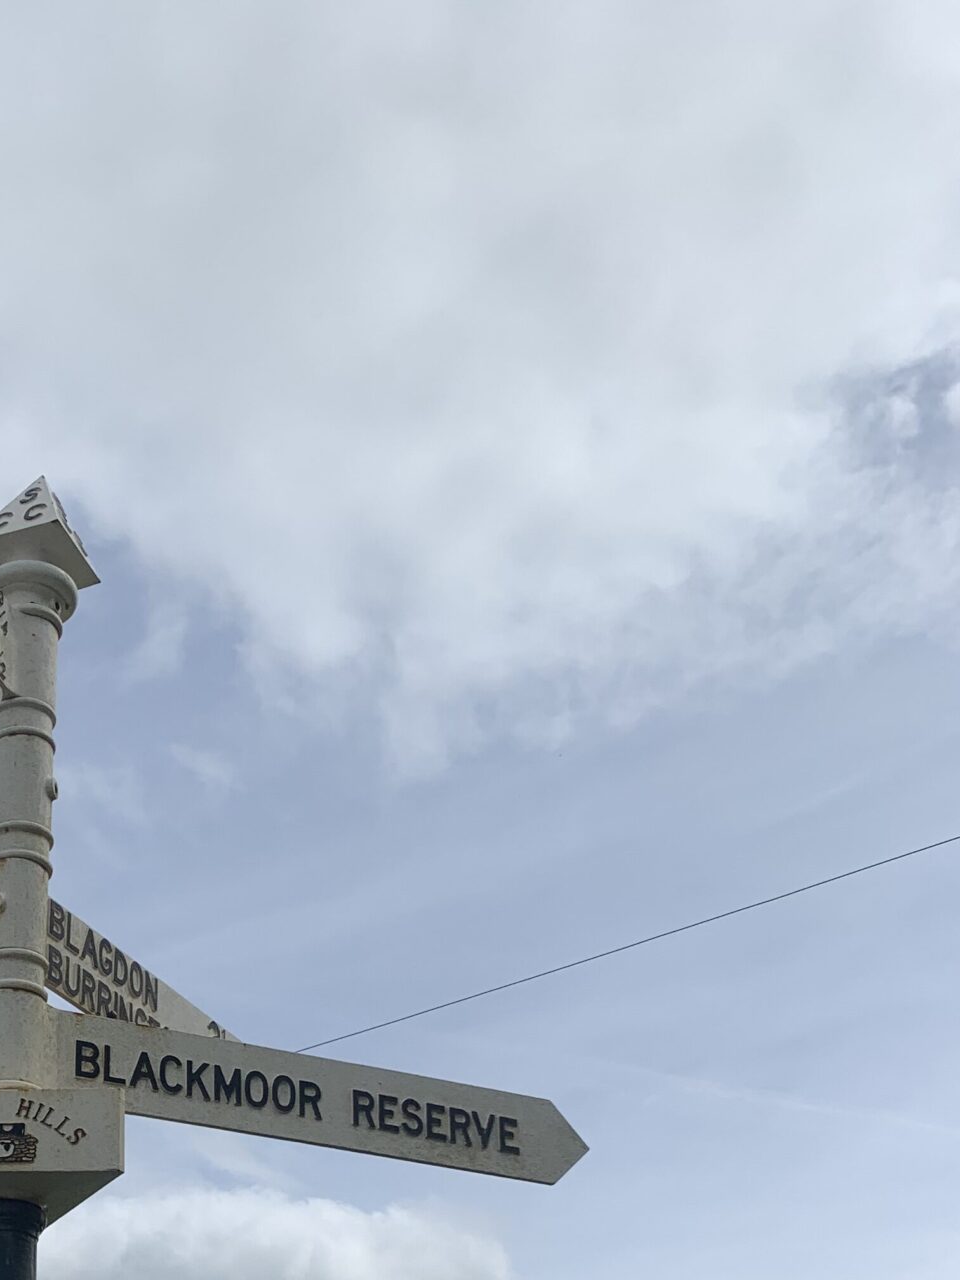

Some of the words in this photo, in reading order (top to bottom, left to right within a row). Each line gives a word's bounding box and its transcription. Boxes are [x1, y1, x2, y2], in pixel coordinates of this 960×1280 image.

[48, 898, 159, 1013] BLAGDON
[15, 1098, 88, 1146] HILLS
[73, 1039, 323, 1121] BLACKMOOR
[351, 1089, 522, 1157] RESERVE
